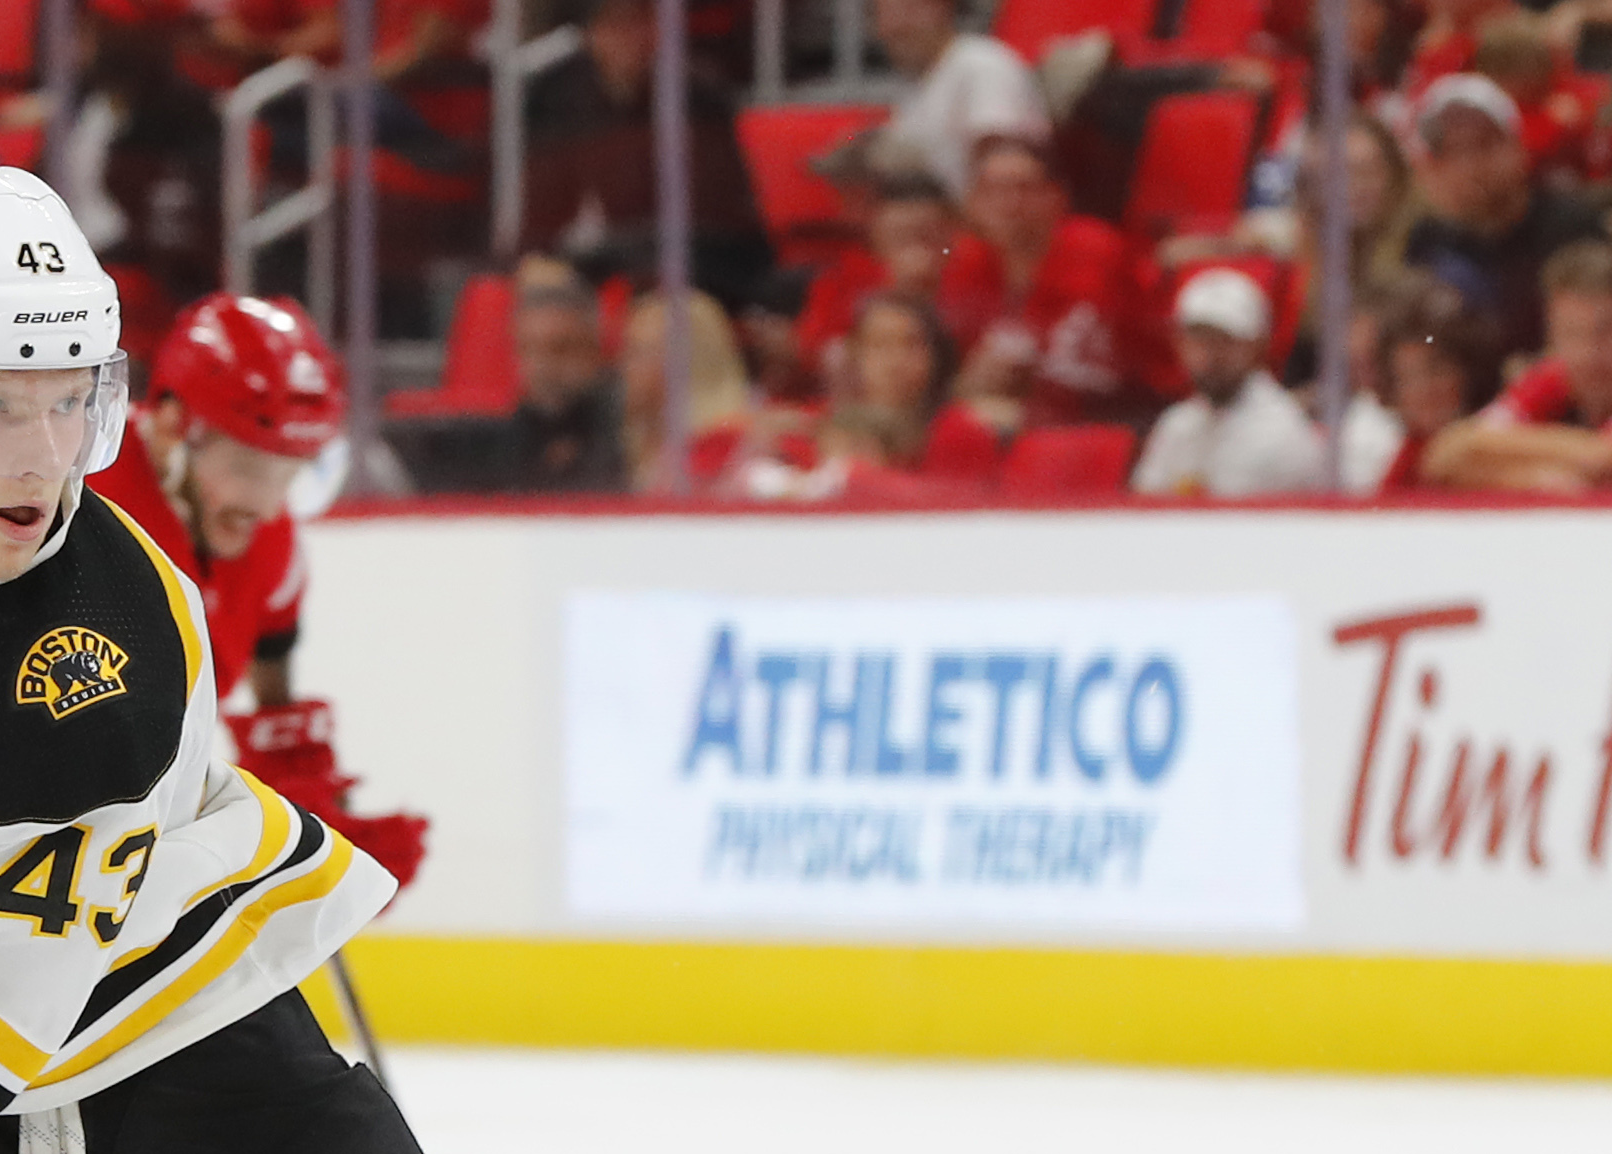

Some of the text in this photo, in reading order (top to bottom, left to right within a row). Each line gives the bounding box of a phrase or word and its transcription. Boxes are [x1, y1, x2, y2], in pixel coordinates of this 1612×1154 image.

[17, 242, 65, 273] 43
[20, 630, 124, 699] BOSTON
[680, 622, 1184, 785] ATHLETICO
[1332, 604, 1552, 866] Tim
